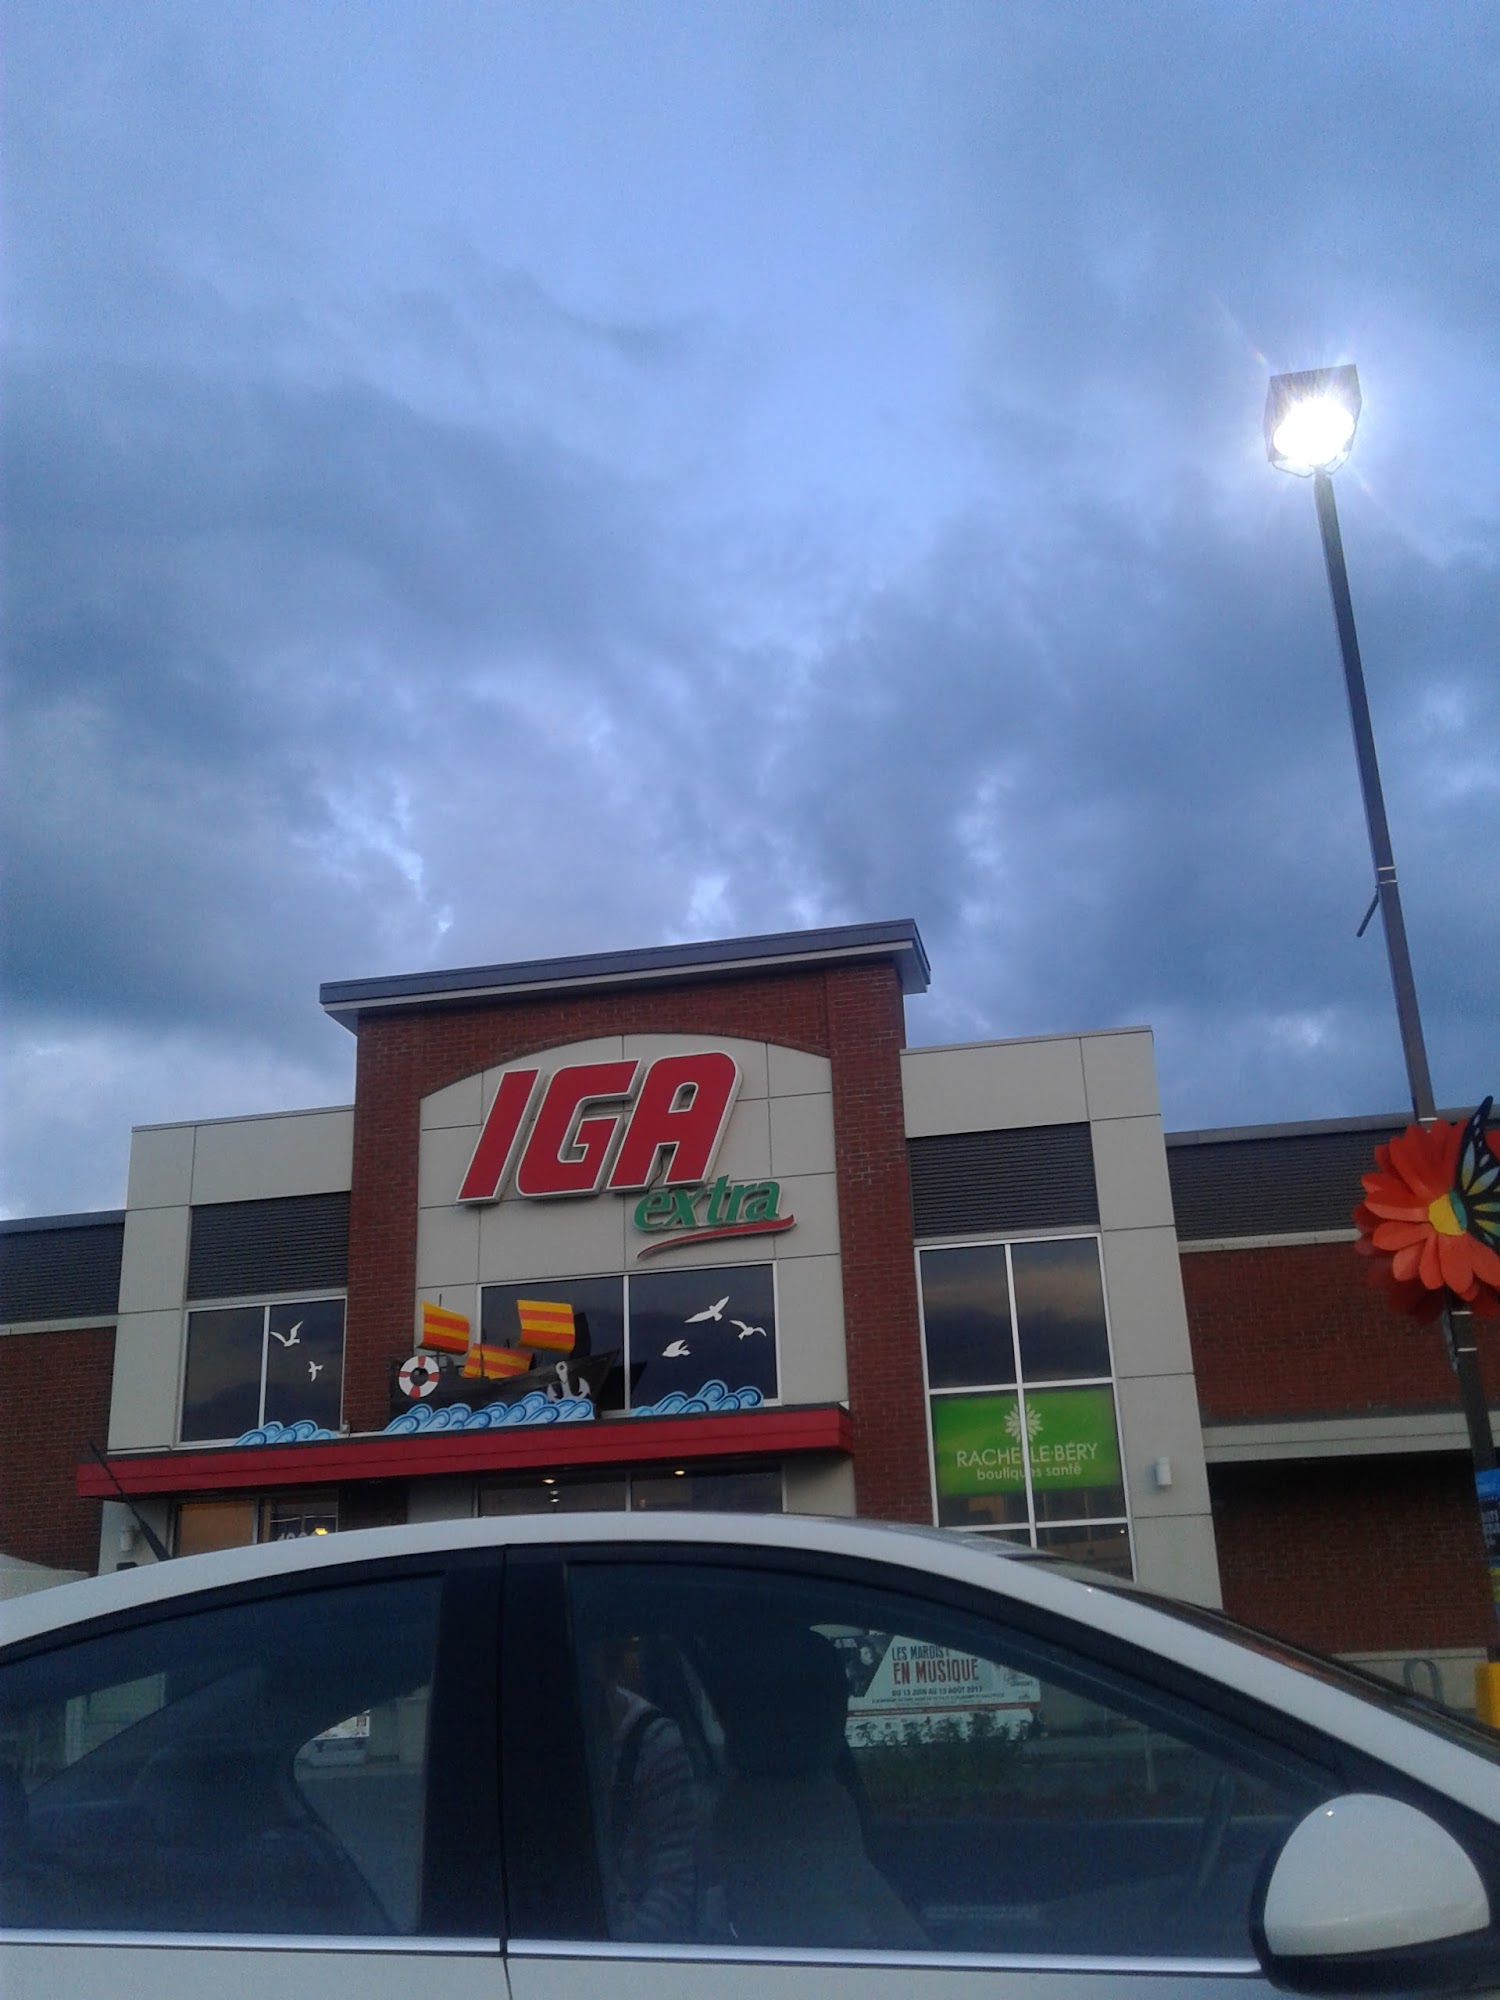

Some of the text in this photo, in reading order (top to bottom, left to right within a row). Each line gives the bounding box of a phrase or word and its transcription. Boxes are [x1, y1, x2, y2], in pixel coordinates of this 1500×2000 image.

[456, 1050, 743, 1206] IGA
[632, 1174, 783, 1233] extra
[1045, 1463, 1082, 1477] santé
[891, 1646, 908, 1661] LES
[911, 1645, 944, 1660] MARDIS
[893, 1662, 911, 1685] EN
[915, 1658, 979, 1684] MUSIQUE
[891, 1689, 901, 1697] DU
[912, 1688, 927, 1696] JUIN
[928, 1687, 937, 1695] AU
[966, 1685, 983, 1693] 2017
